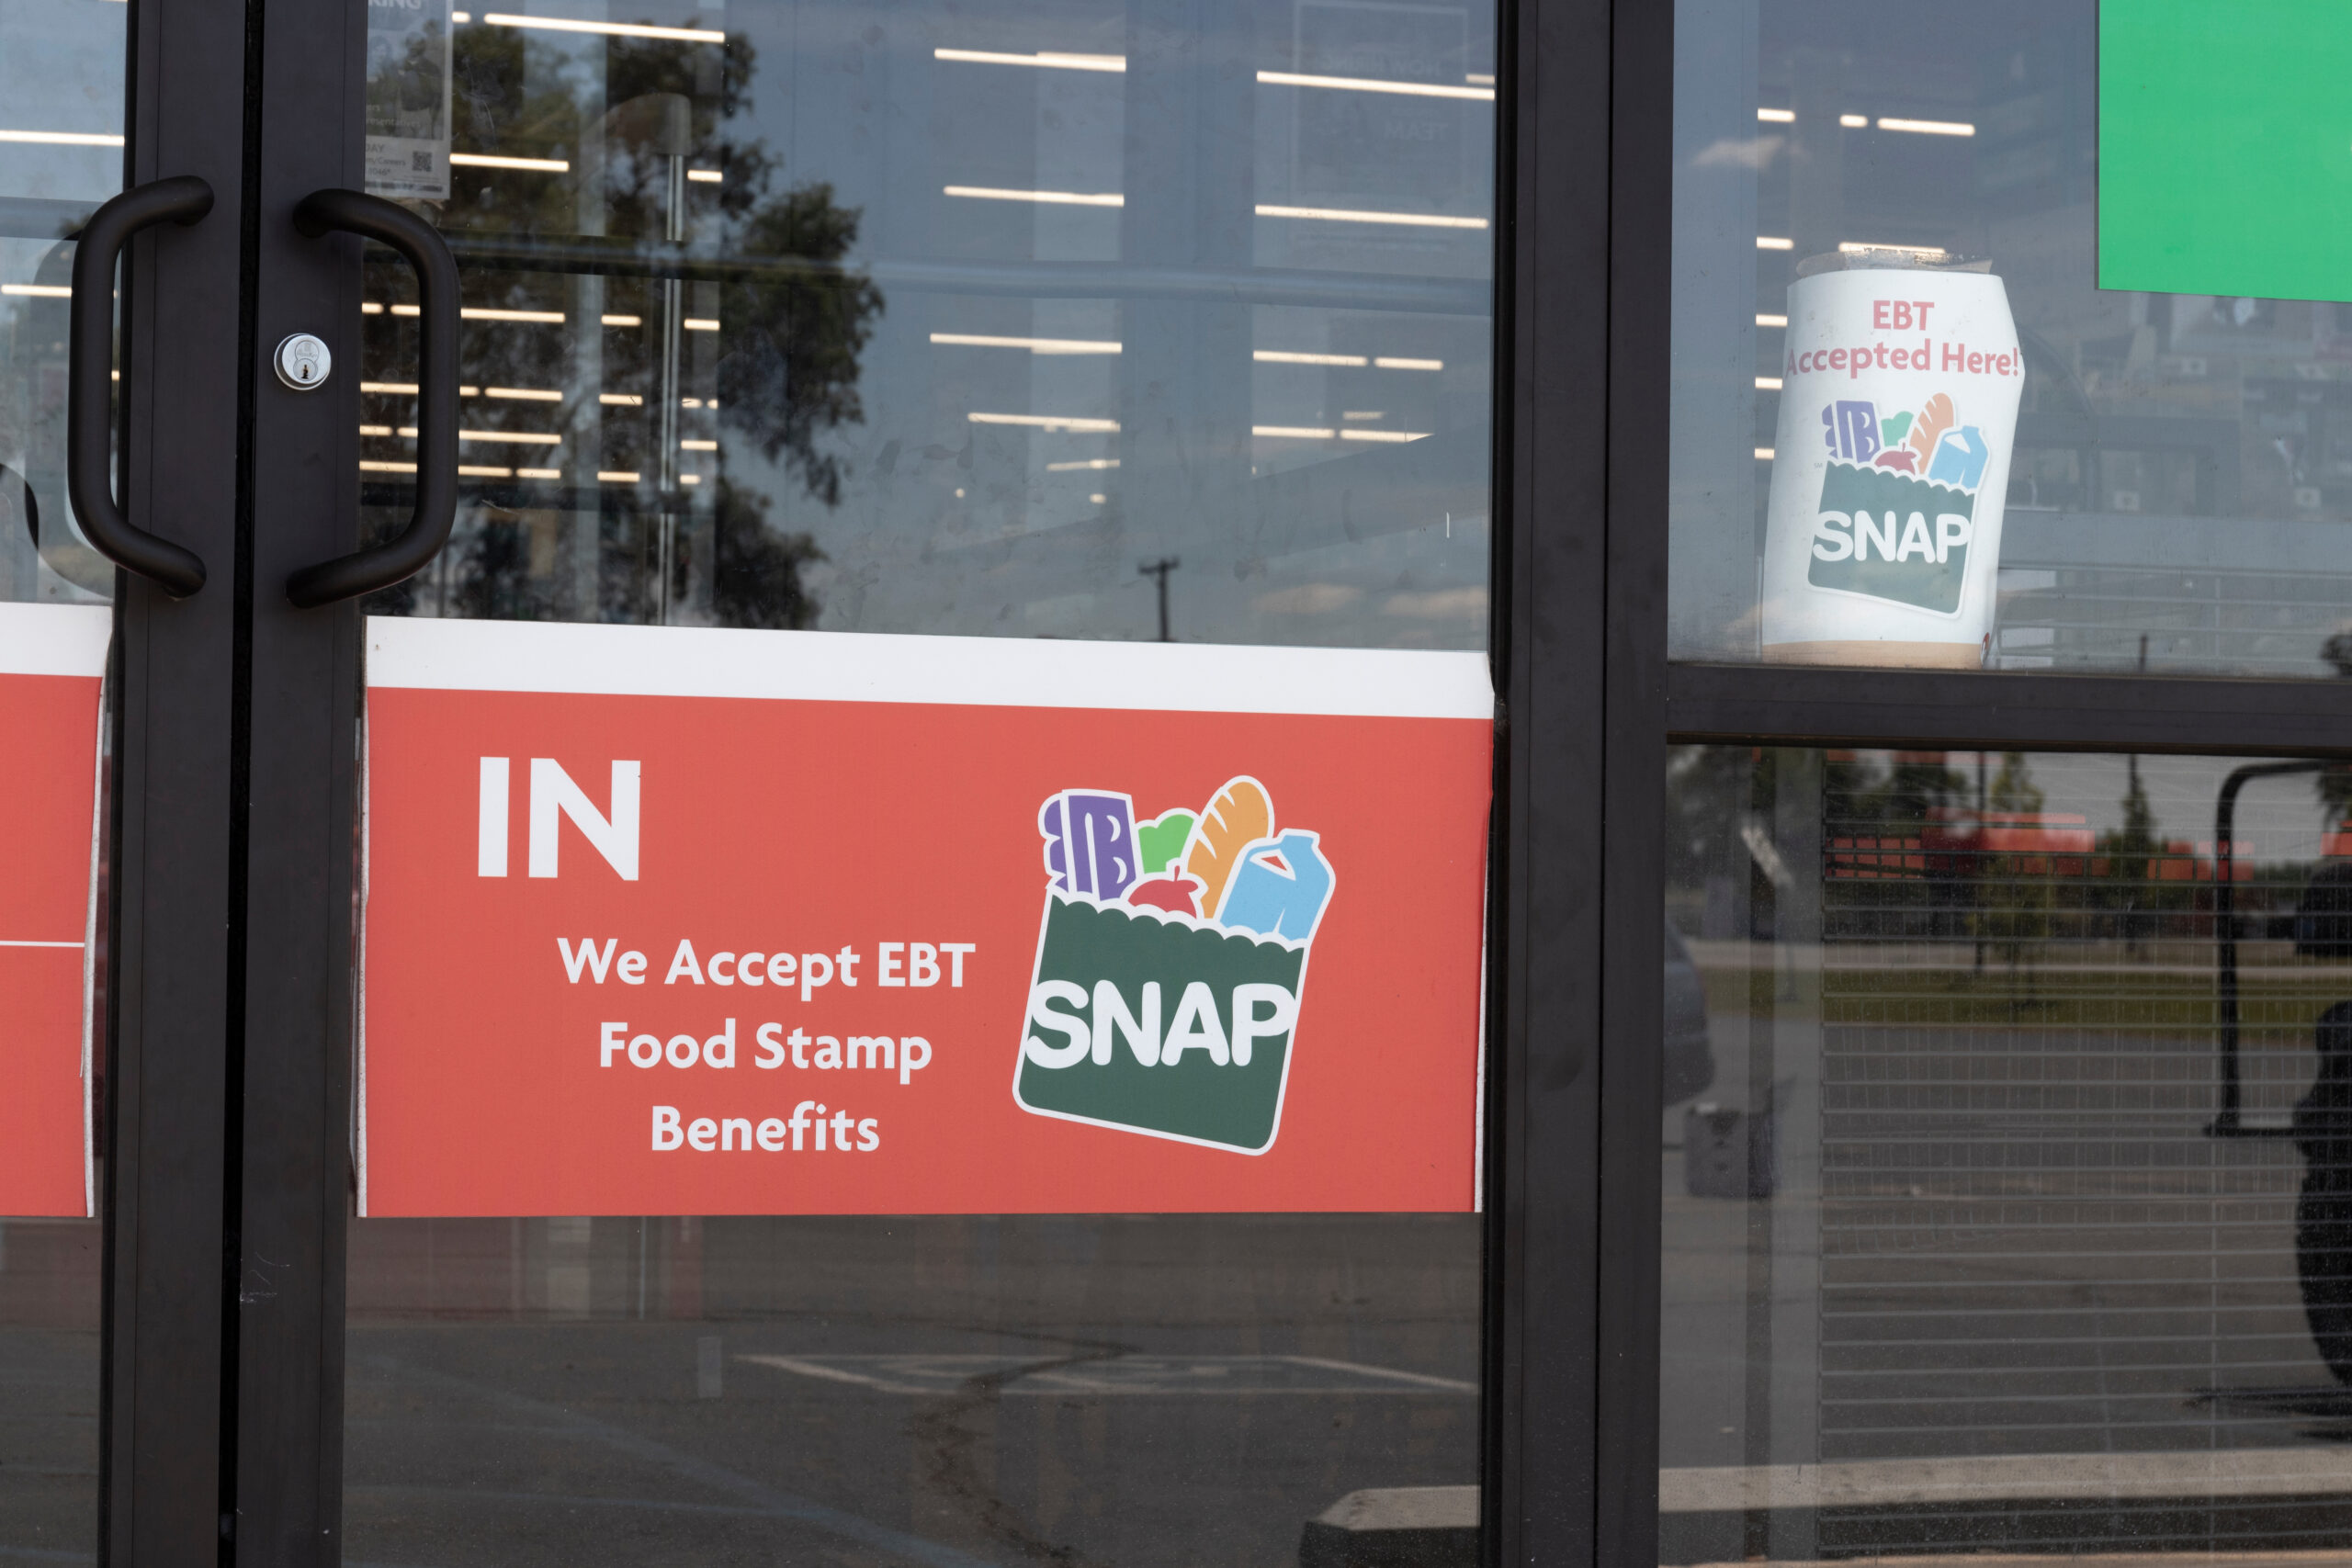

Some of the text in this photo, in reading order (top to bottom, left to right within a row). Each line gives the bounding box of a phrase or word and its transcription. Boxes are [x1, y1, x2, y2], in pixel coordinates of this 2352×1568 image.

[1873, 300, 1935, 331] EBT
[1785, 338, 2018, 378] Accepted Here!
[1812, 510, 1973, 564] SNAP
[478, 756, 641, 881] IN
[556, 937, 977, 1002] We Accept EBT
[600, 1017, 933, 1086] Food Stamp
[1024, 979, 1296, 1069] SNAP
[651, 1100, 880, 1152] Benefits
